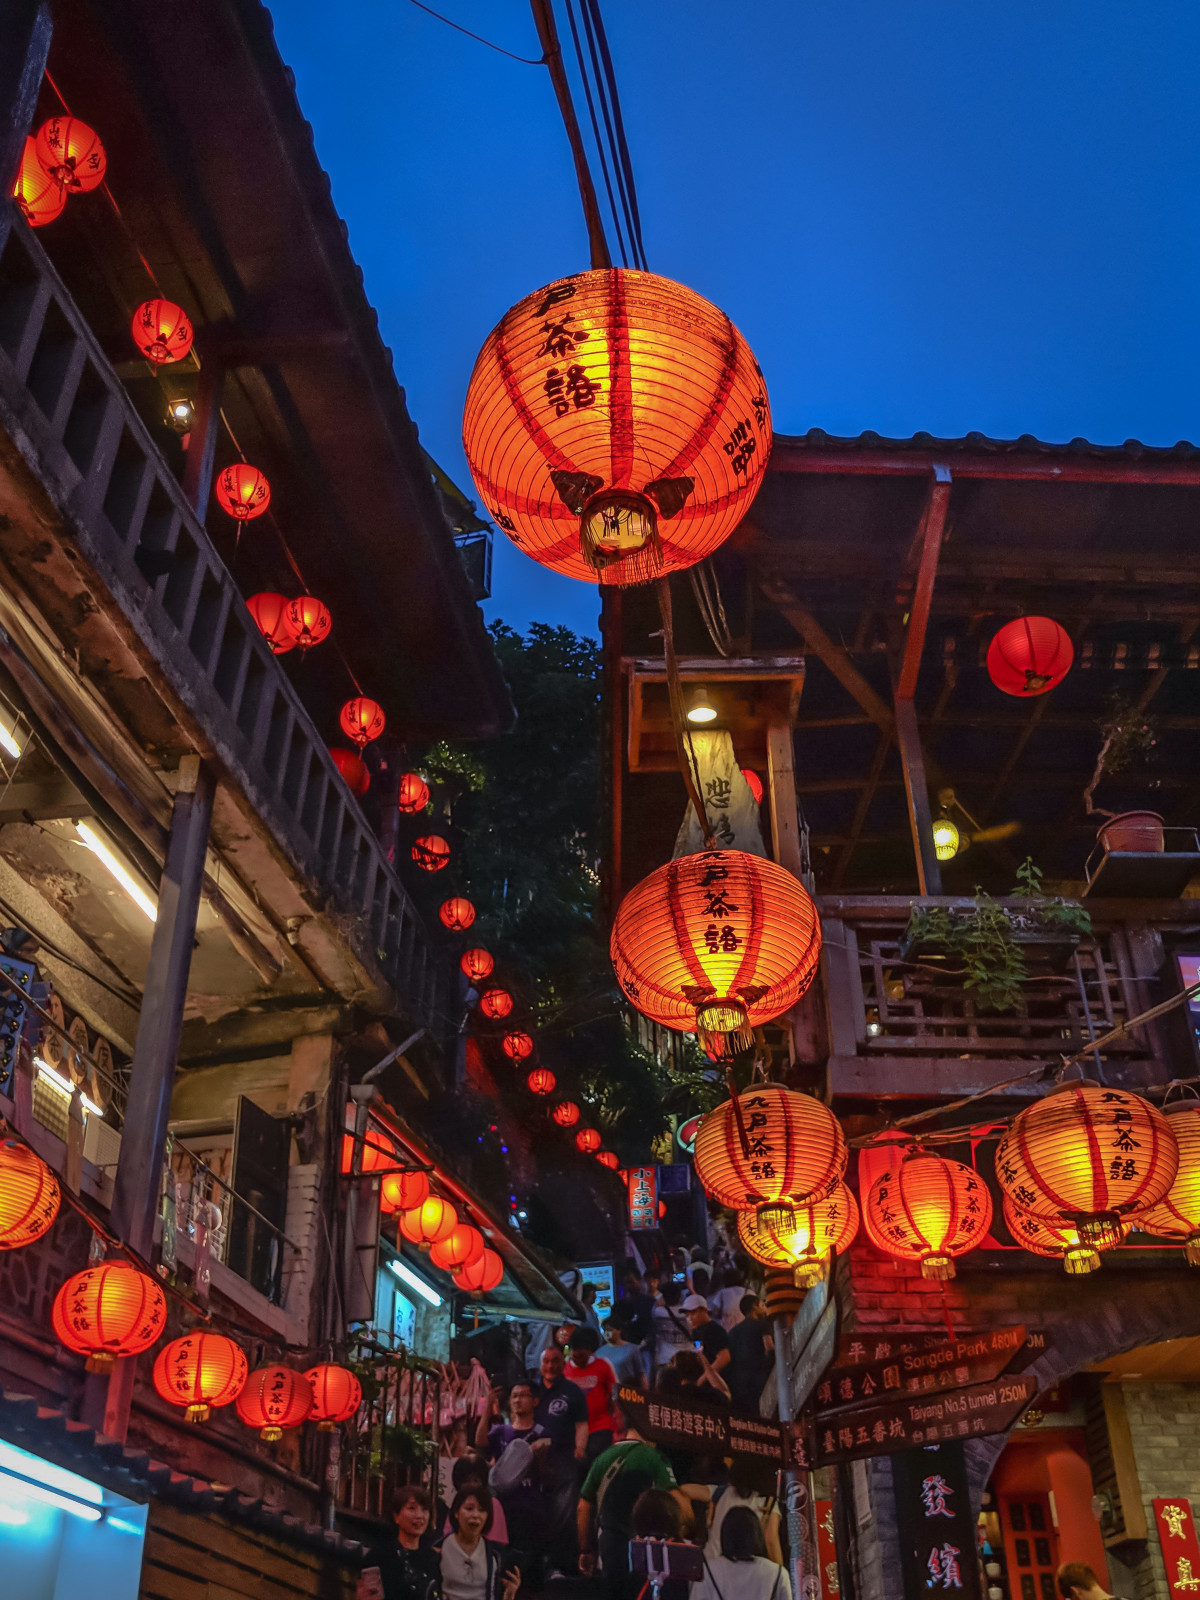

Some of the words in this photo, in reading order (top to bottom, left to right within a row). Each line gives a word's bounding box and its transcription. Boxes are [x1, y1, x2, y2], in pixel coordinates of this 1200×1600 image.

[535, 273, 602, 418] 戶茶語
[904, 1347, 954, 1371] Songde
[956, 1340, 989, 1360] Park
[908, 1404, 944, 1422] Taiyang
[968, 1389, 998, 1409] tunnel
[999, 1383, 1028, 1404] 250M
